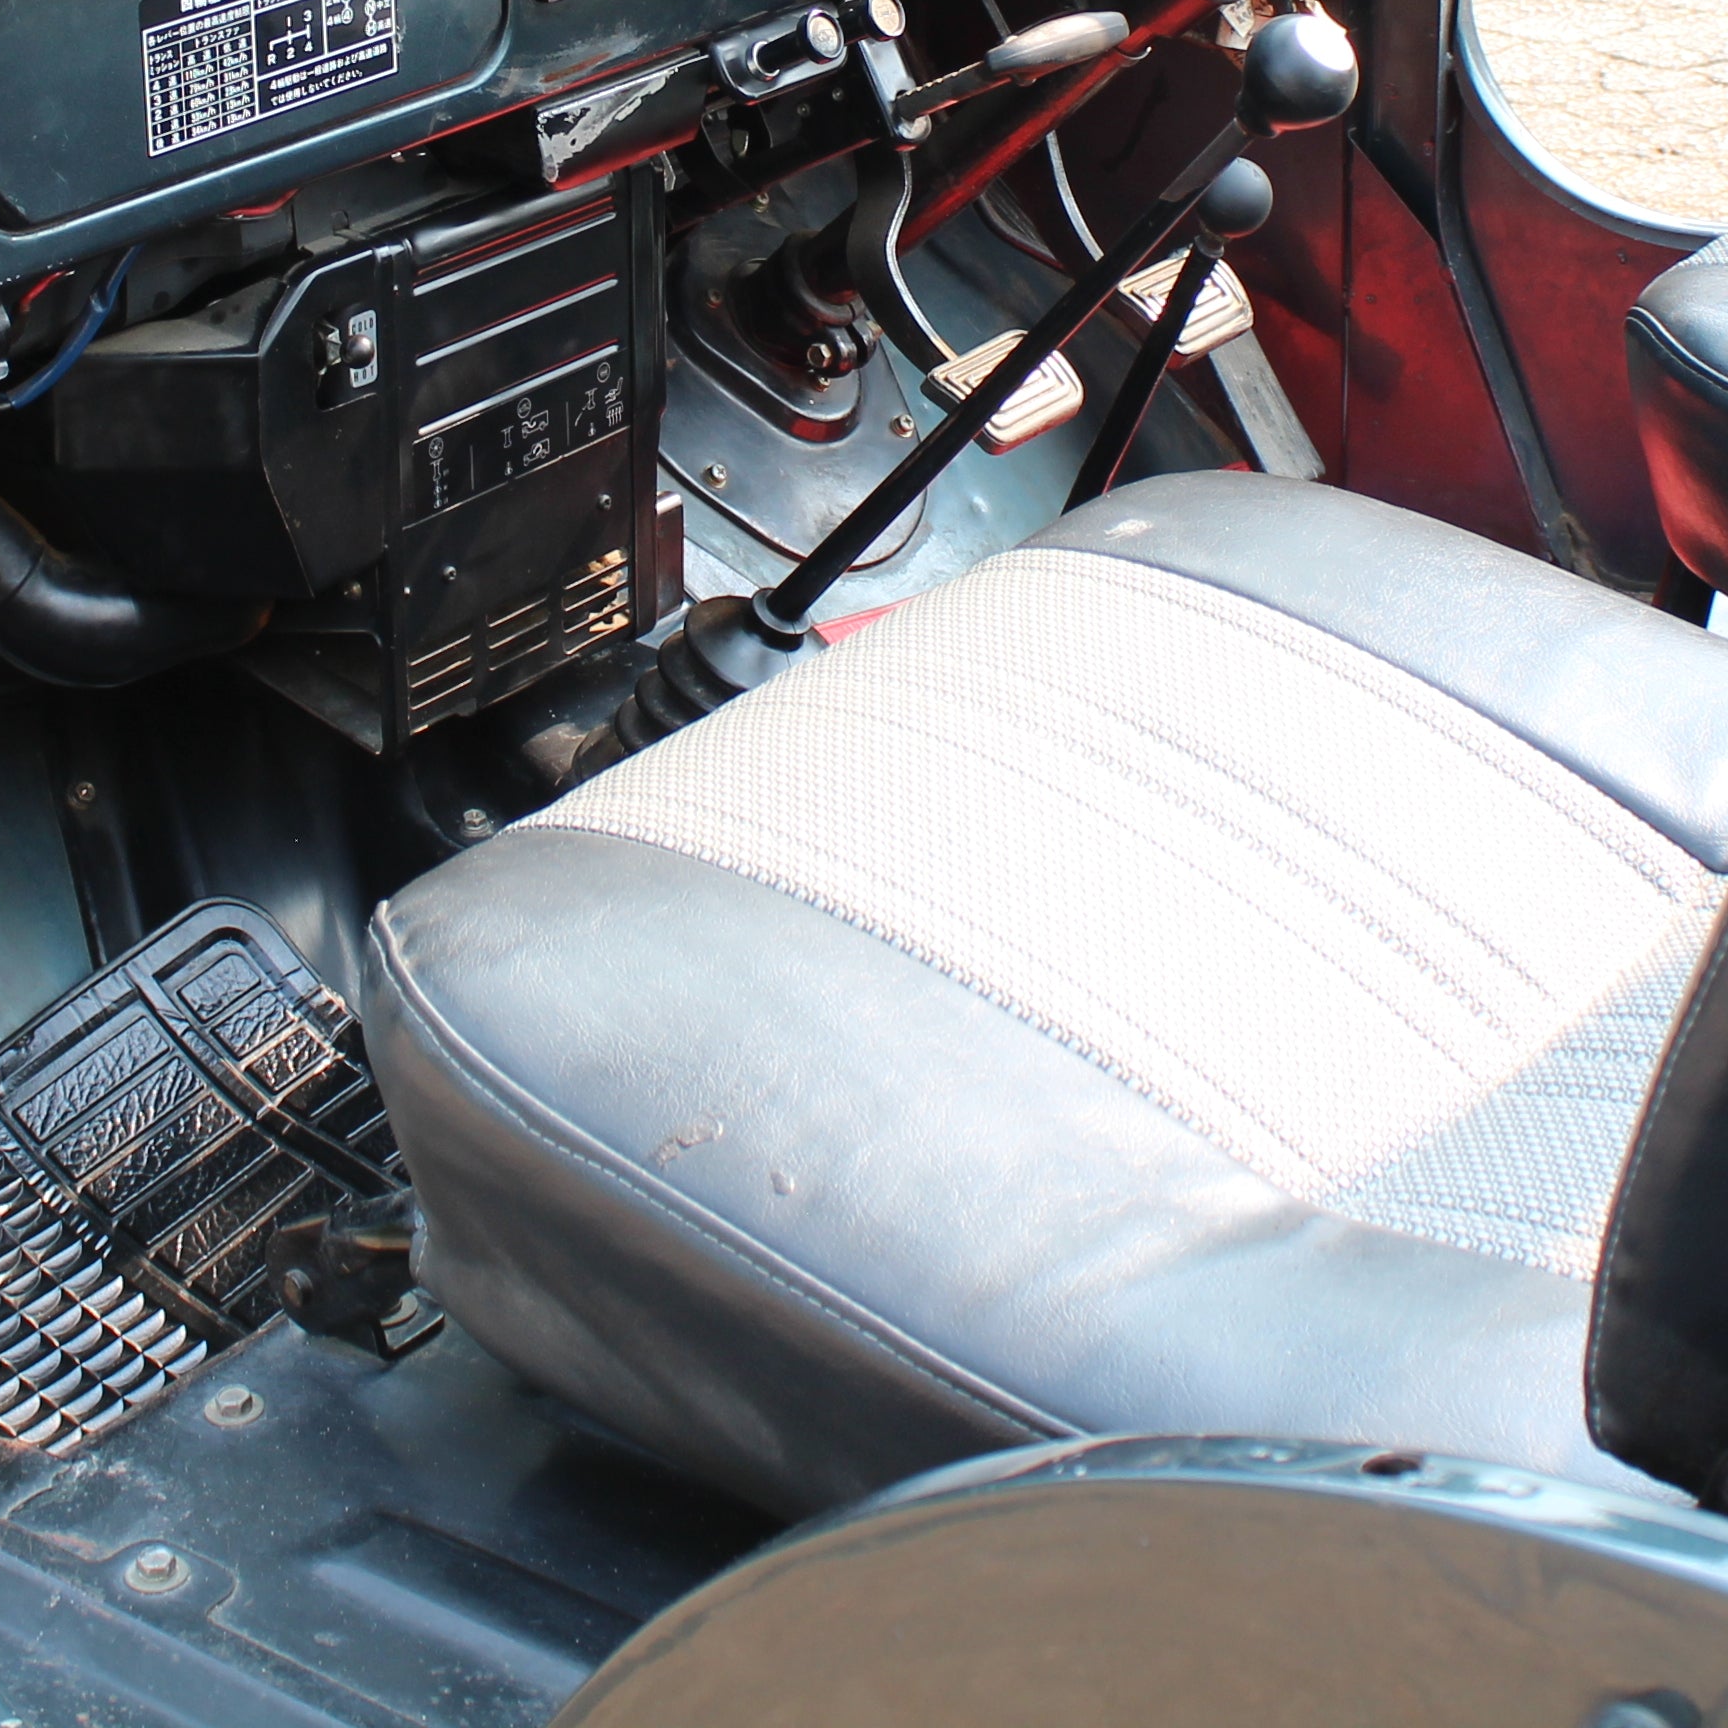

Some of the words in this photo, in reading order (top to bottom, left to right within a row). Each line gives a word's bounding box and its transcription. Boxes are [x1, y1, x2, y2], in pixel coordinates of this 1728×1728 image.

[303, 9, 312, 22] 3
[149, 50, 174, 65] トランス
[267, 53, 277, 66] R
[286, 47, 296, 60] 2
[304, 41, 313, 52] 4
[150, 59, 180, 76] ミッション
[352, 317, 374, 335] COLD
[354, 365, 374, 382] HOT
